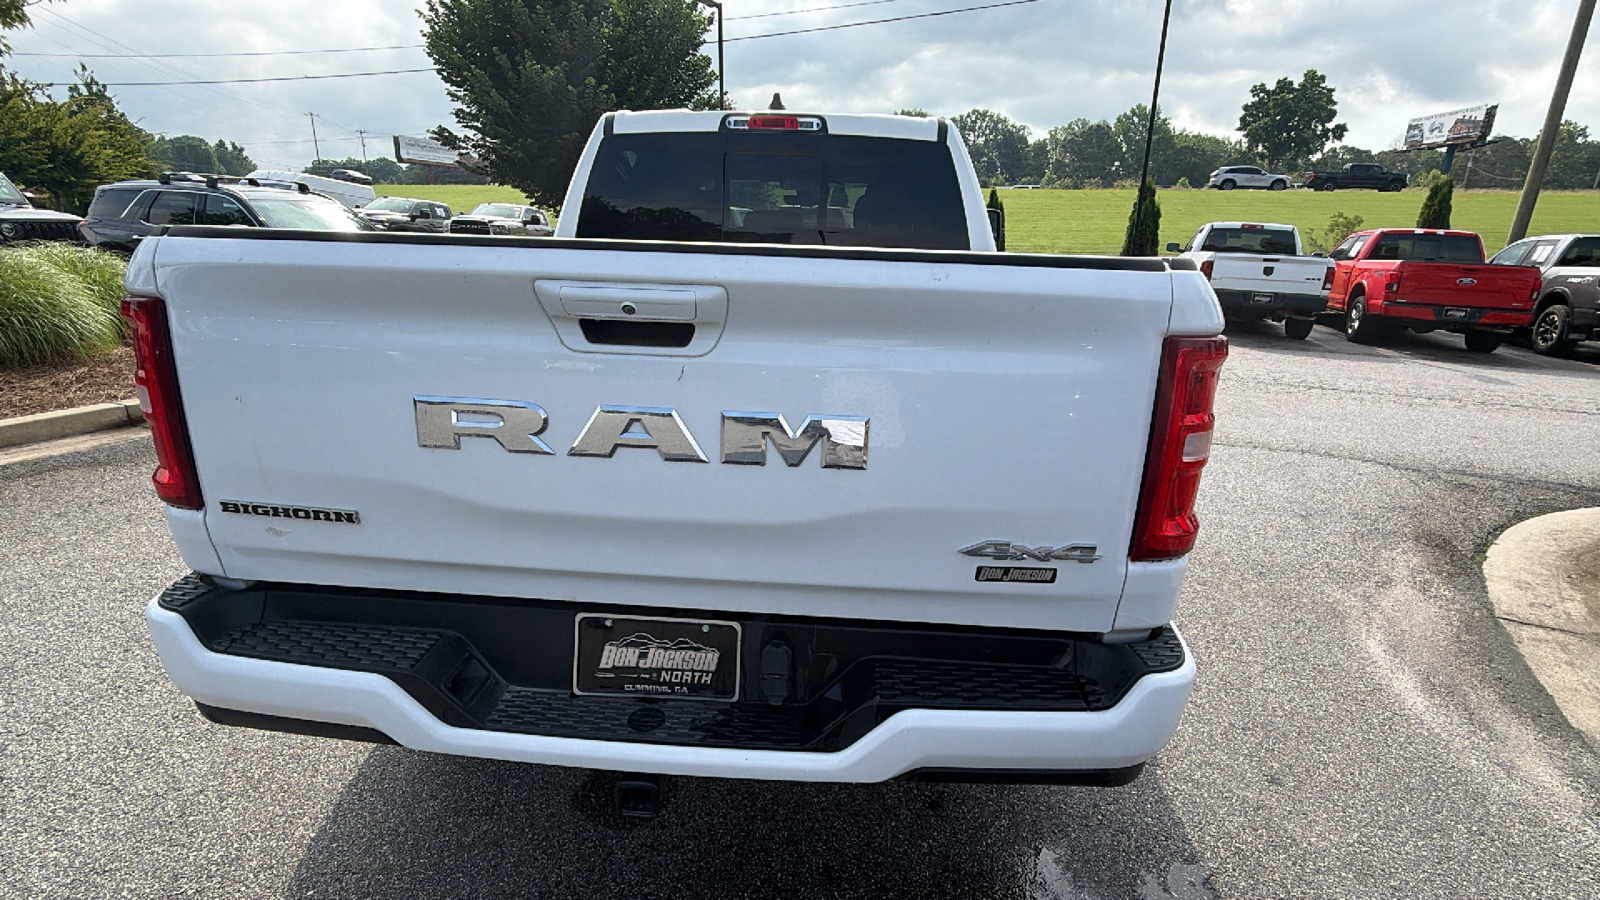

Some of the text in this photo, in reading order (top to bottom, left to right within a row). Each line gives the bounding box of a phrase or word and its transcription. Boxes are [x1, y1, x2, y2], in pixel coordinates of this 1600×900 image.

[413, 395, 871, 470] RAM
[219, 499, 360, 525] BIGHORN
[977, 567, 1054, 582] DON JACKSON
[598, 645, 720, 672] DON JACKSON
[660, 670, 713, 684] NORTH
[674, 686, 689, 694] GA
